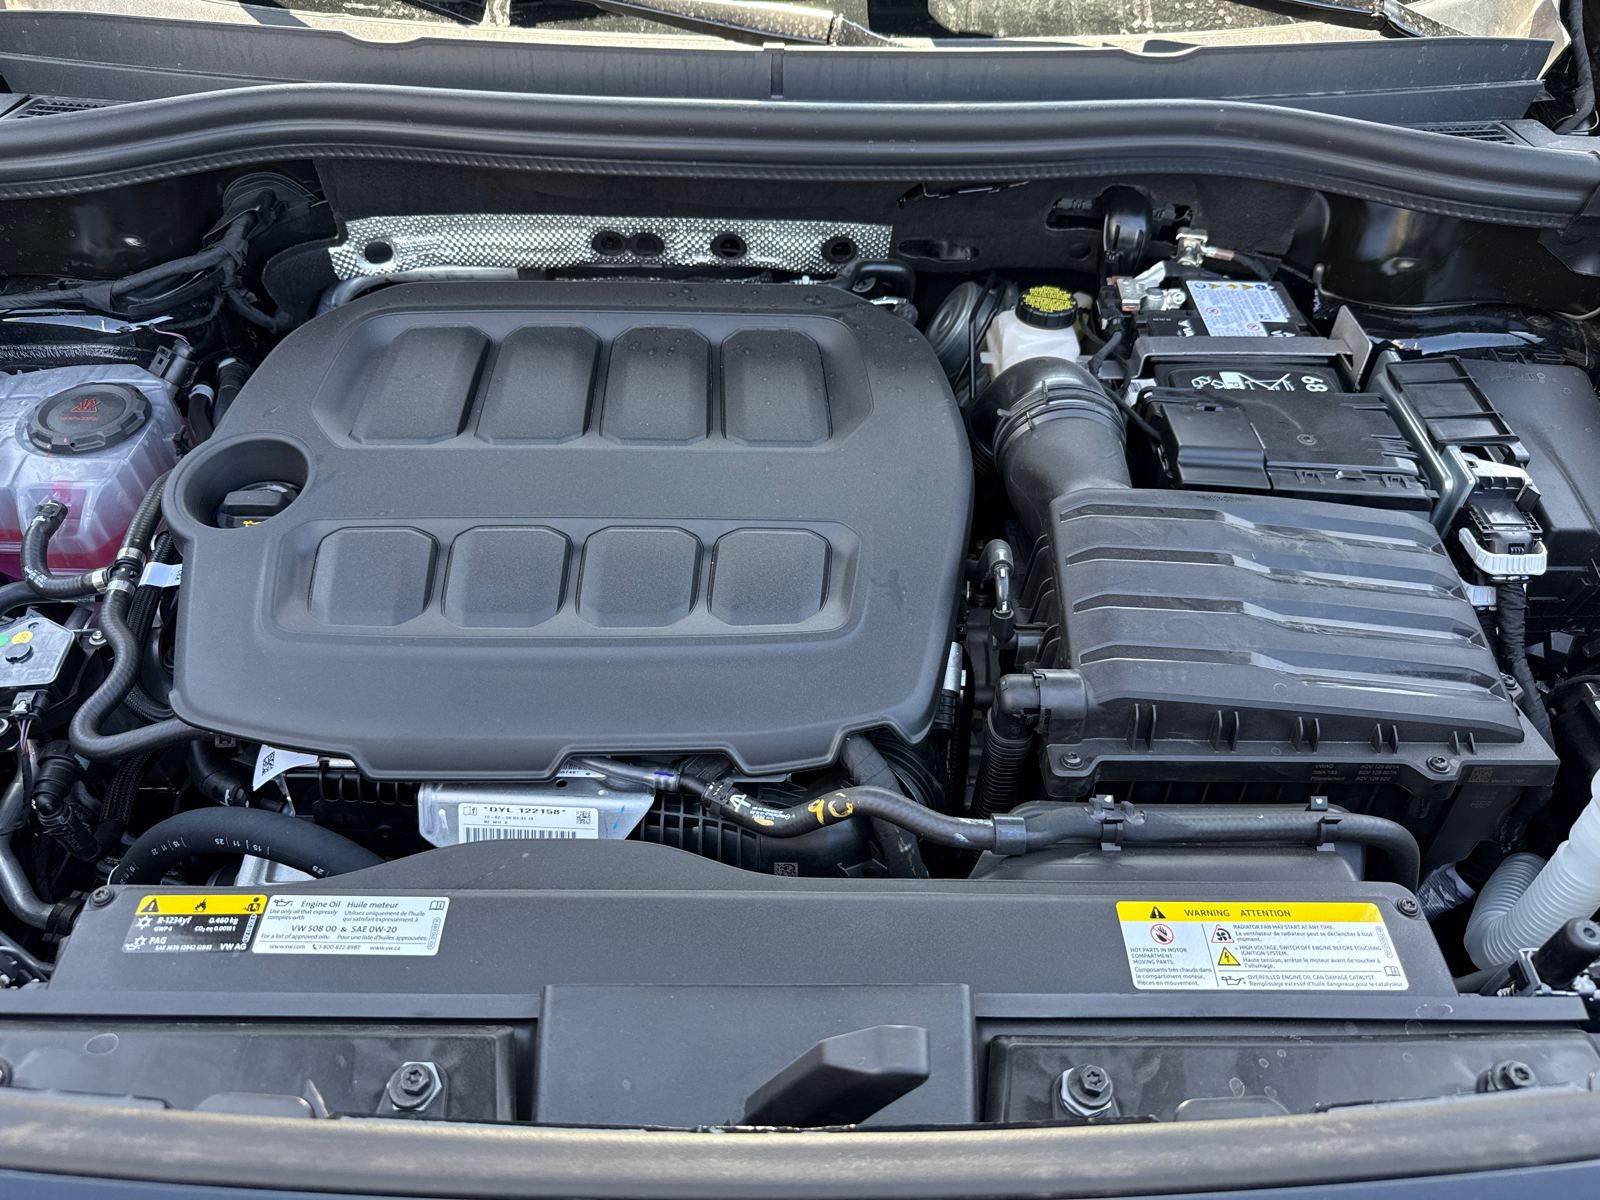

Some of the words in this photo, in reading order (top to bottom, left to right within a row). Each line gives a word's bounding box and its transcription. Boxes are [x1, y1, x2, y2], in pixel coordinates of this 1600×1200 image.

[301, 901, 328, 909] Engine
[157, 916, 192, 926] R-1234yf
[230, 917, 239, 925] kg
